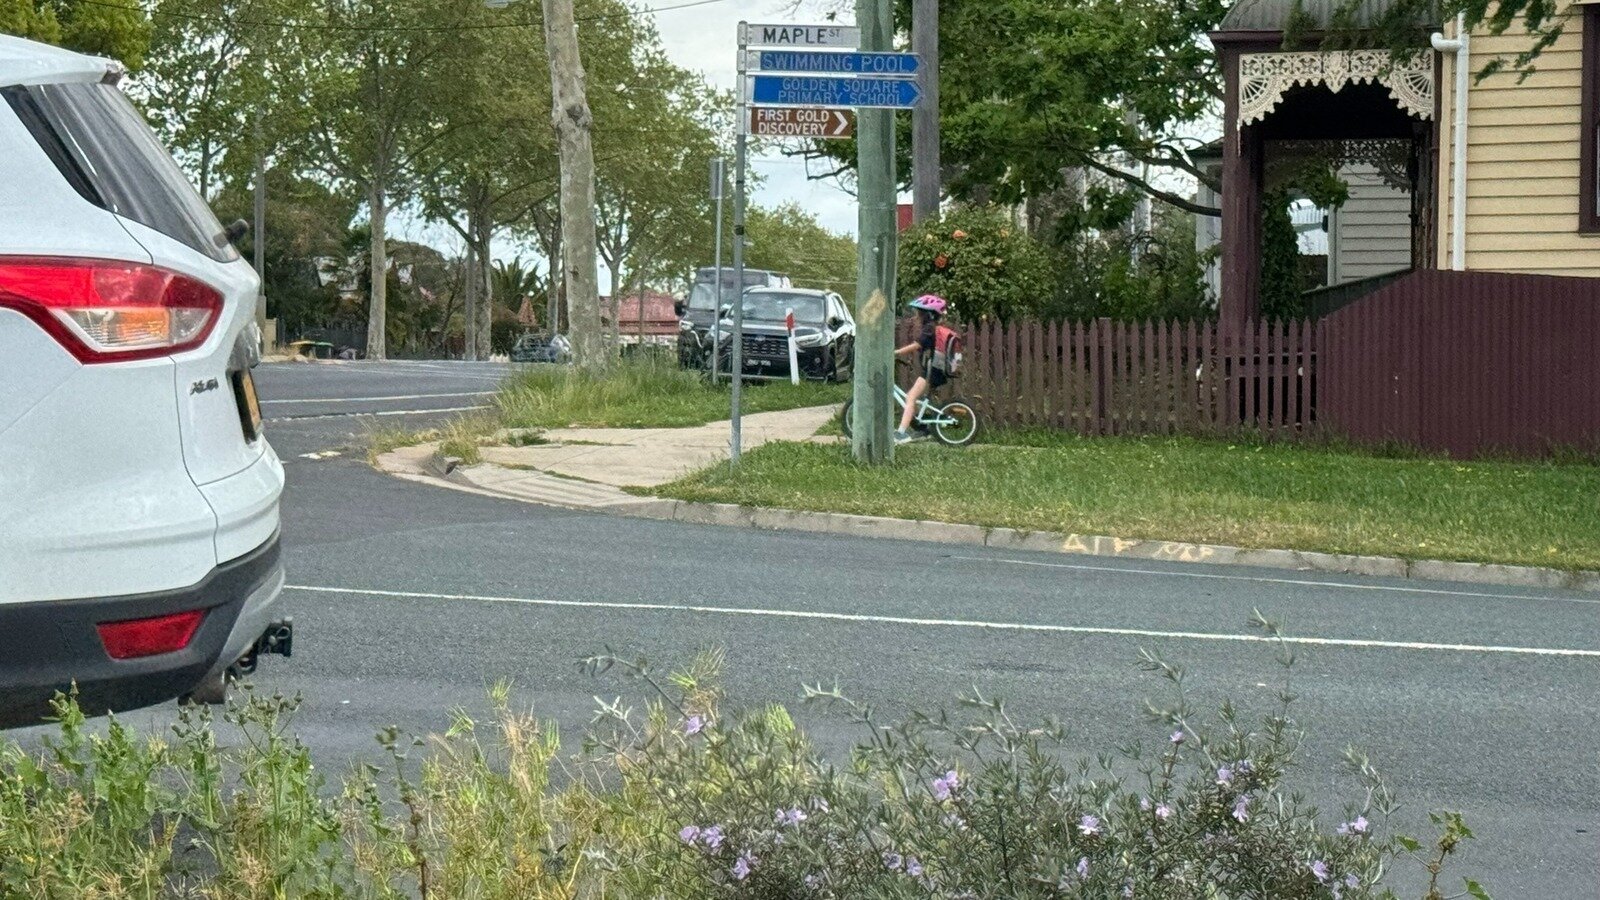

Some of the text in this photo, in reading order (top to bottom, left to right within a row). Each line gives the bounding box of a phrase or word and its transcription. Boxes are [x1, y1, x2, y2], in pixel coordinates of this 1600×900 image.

[763, 27, 842, 44] MAPLE ST
[762, 53, 908, 73] SWIMMING POOL
[782, 78, 900, 94] GOLDEN SQUARE
[778, 90, 904, 106] PRIMARY SCHOOL
[757, 109, 829, 122] FIRST GOLD
[758, 122, 828, 135] DISCOVERY
